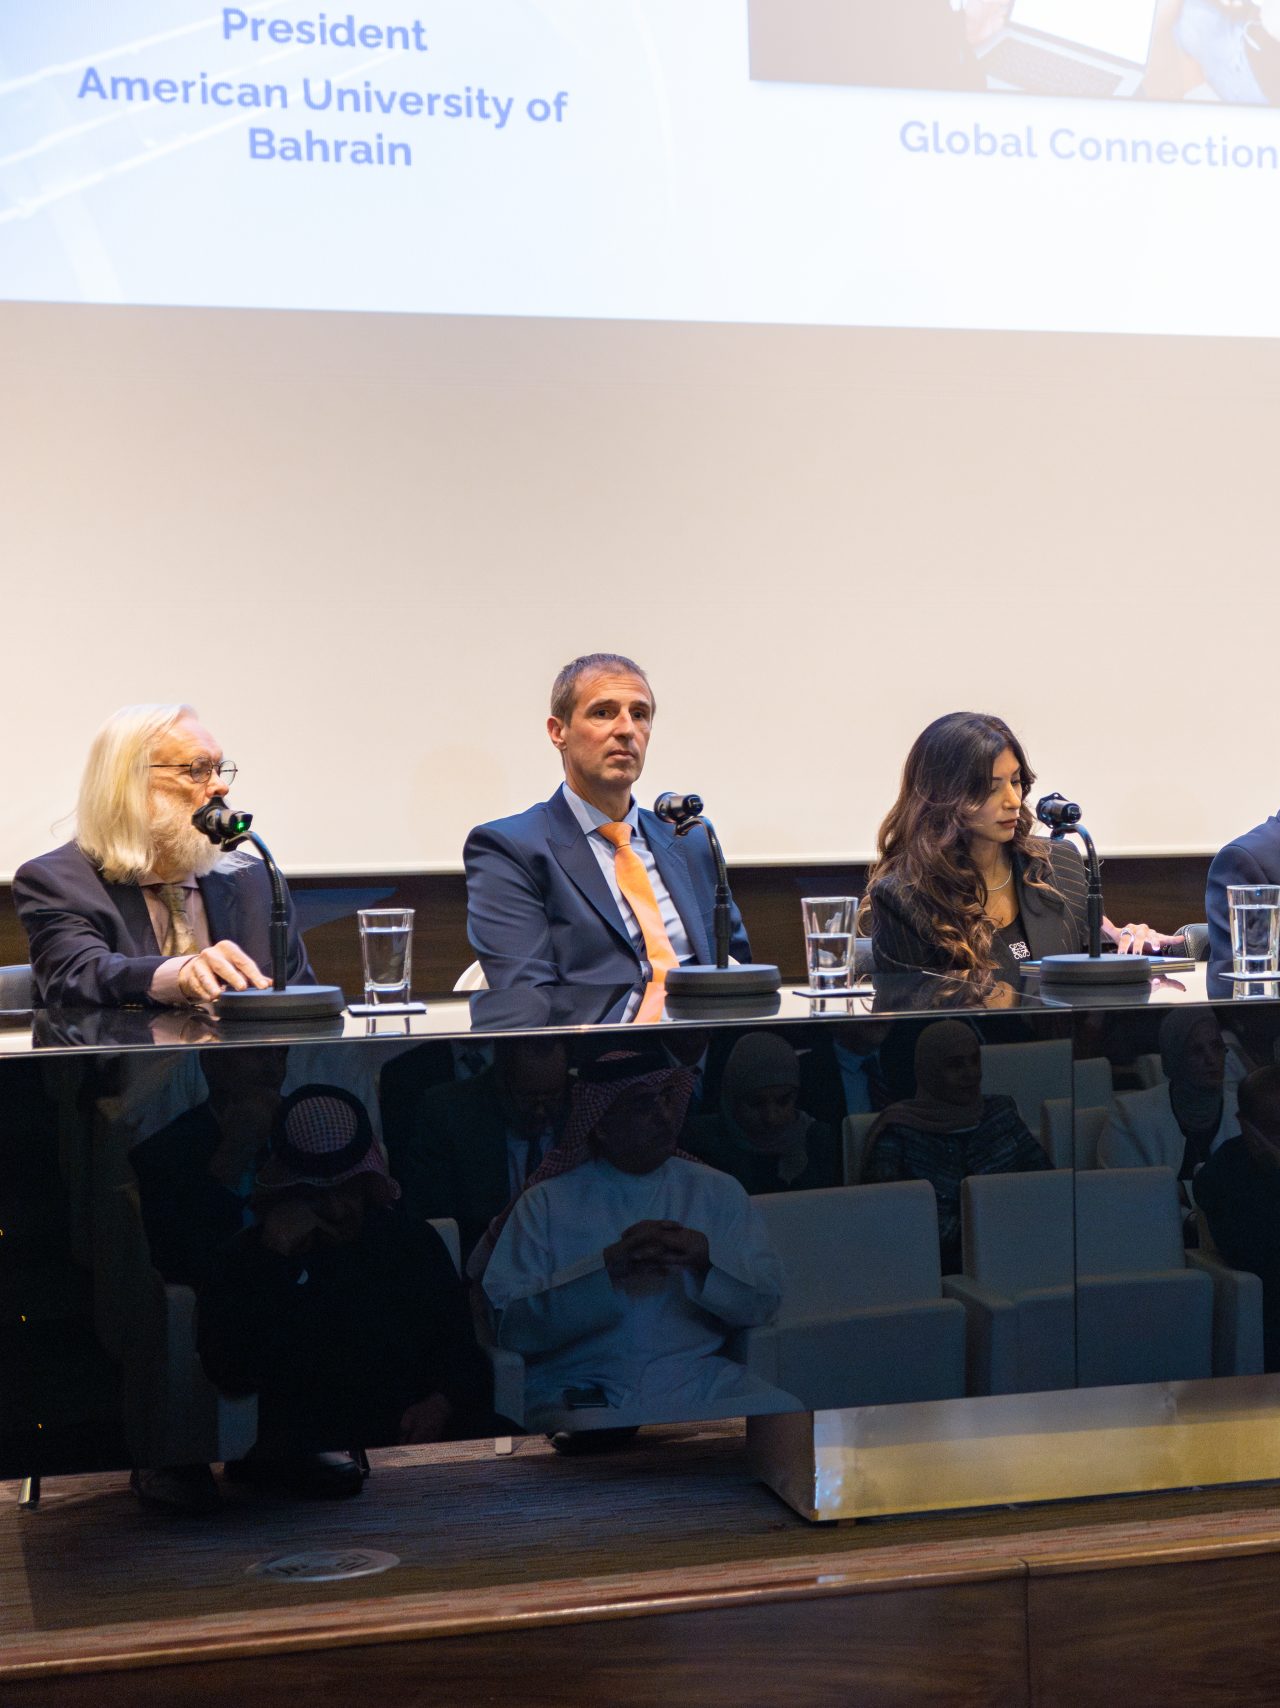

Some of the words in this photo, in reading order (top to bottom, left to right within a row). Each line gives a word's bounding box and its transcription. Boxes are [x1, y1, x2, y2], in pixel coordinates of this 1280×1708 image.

[222, 8, 428, 52] President
[77, 67, 289, 109] American
[303, 79, 514, 129] University
[526, 91, 569, 123] of
[248, 128, 413, 166] Bahrain
[899, 120, 1037, 159] Global
